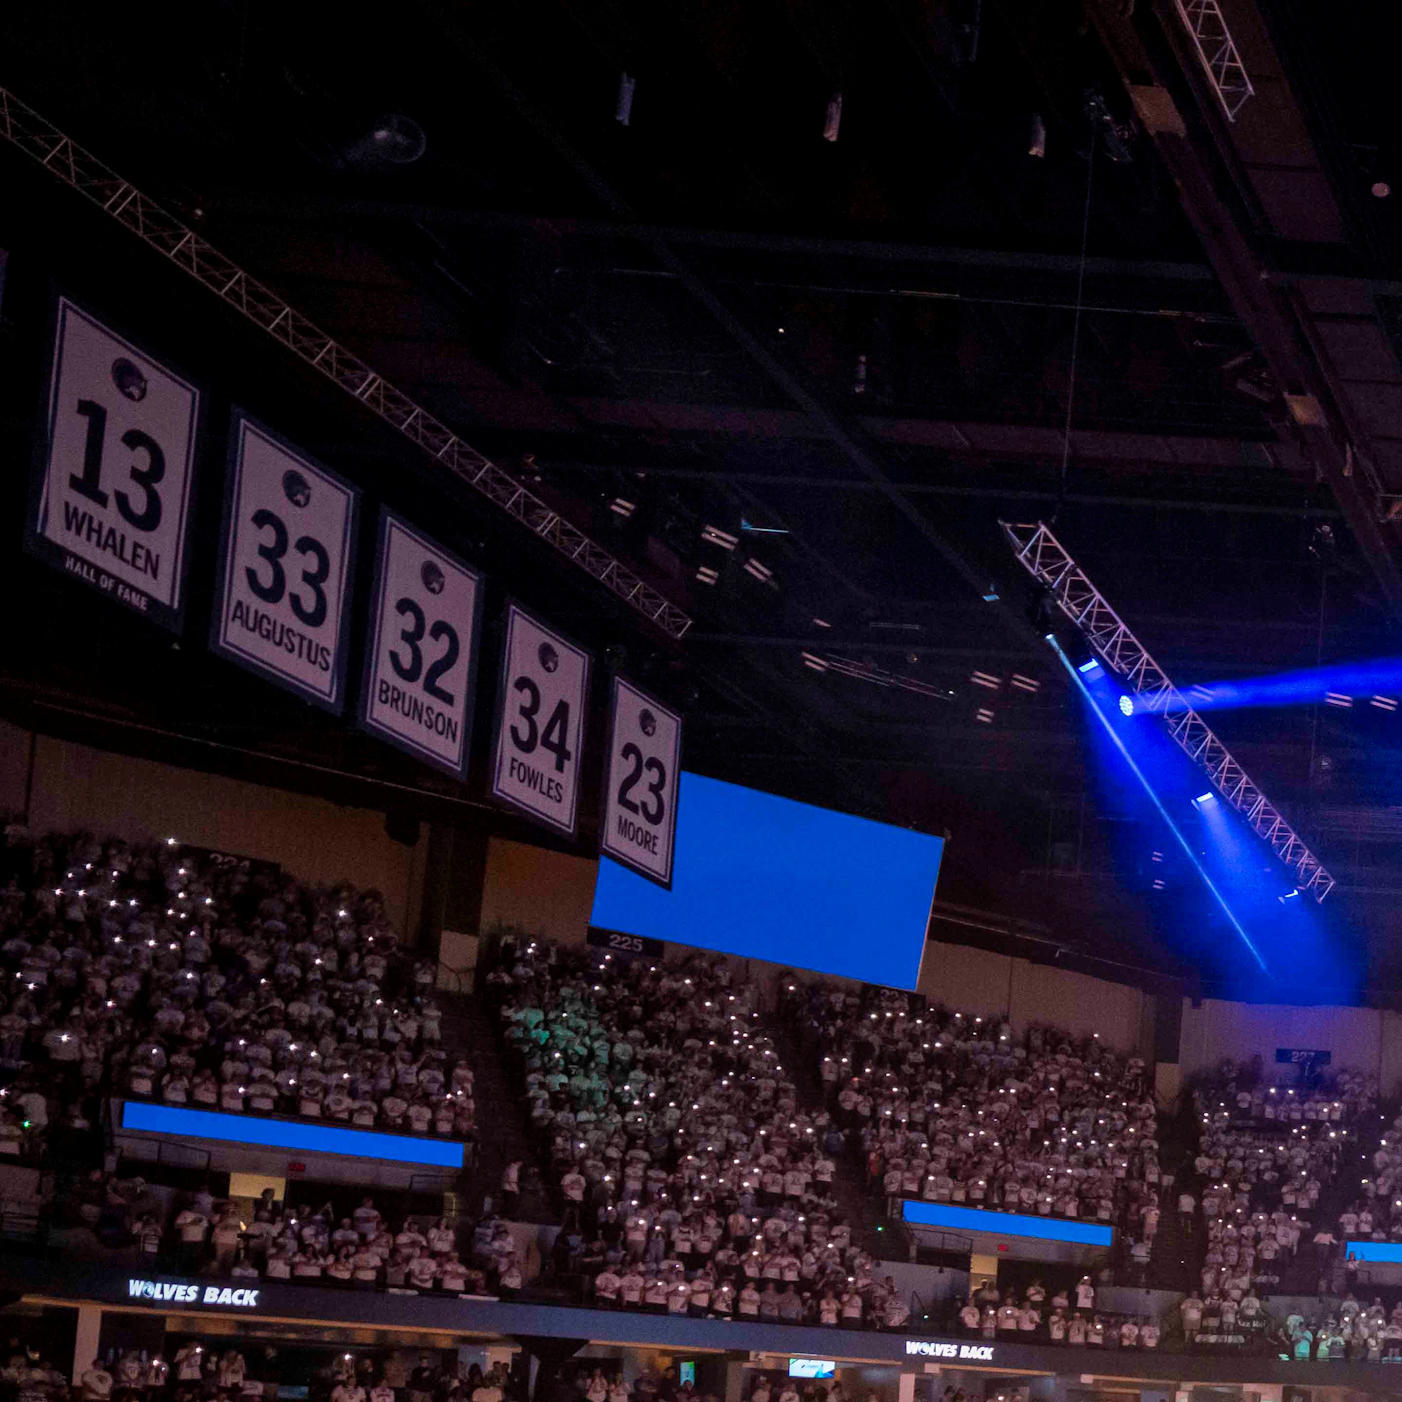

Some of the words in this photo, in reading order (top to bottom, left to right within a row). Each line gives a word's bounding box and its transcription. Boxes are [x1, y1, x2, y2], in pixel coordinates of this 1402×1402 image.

[69, 398, 165, 532] 13
[64, 501, 160, 580] WHALEN
[245, 509, 330, 628] 33
[65, 553, 96, 584] HALL
[100, 572, 115, 592] OF
[117, 581, 148, 611] FAME
[231, 600, 331, 672] AUGUSTUS
[389, 597, 460, 706] 32
[378, 679, 458, 744] BRUNSON
[510, 676, 571, 773] 34
[509, 757, 564, 803] FOWLES
[618, 742, 666, 826] 23
[617, 815, 658, 855] MOORE
[610, 934, 644, 952] 225
[128, 1279, 199, 1303] WOLVES
[203, 1286, 260, 1307] BACK
[906, 1341, 957, 1358] WOLVES
[959, 1345, 994, 1360] BACK
